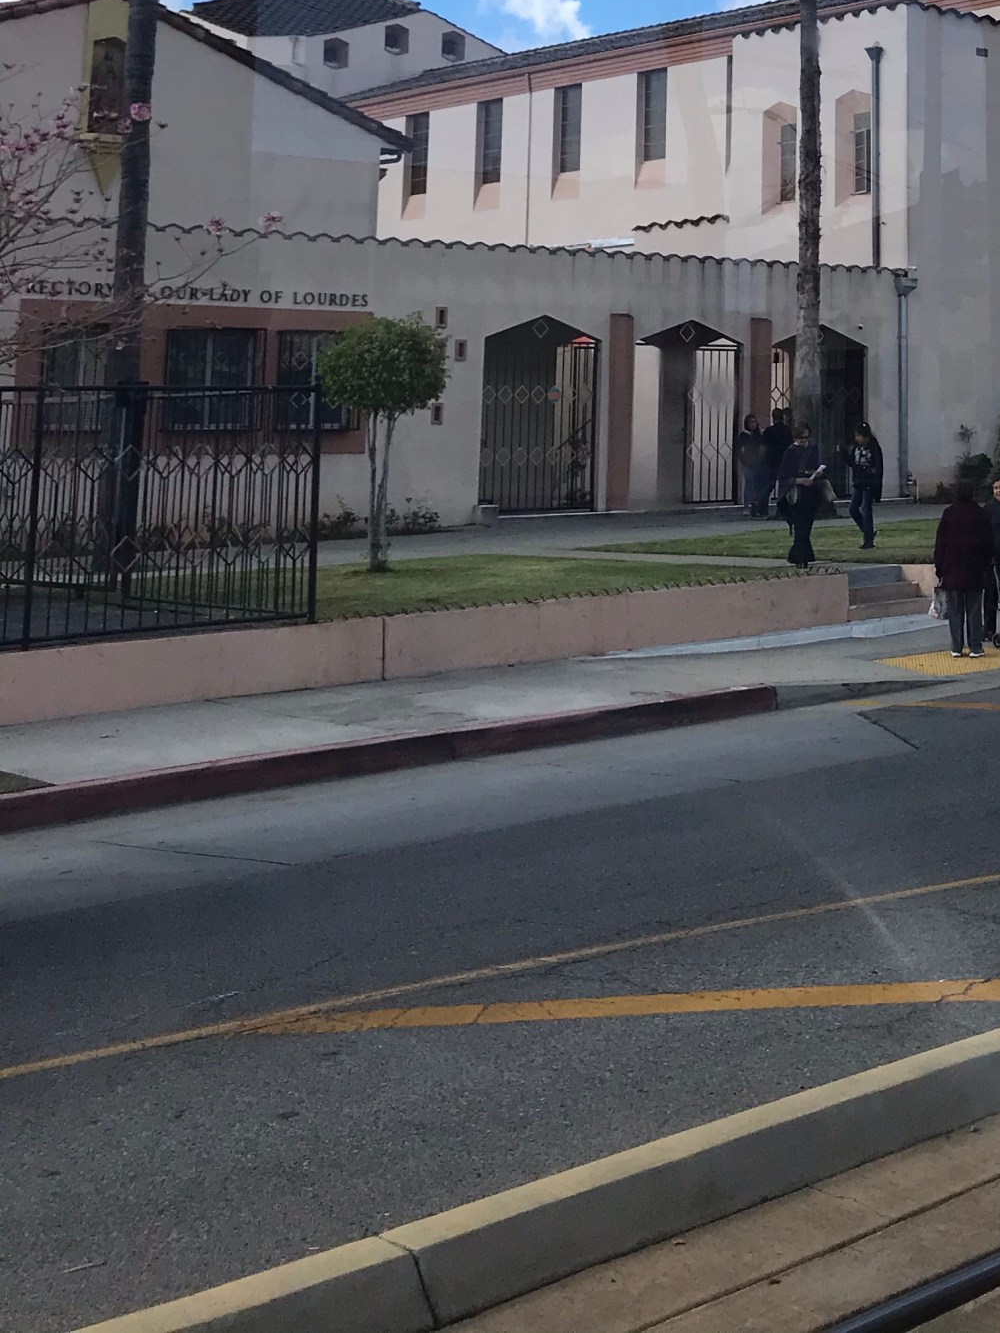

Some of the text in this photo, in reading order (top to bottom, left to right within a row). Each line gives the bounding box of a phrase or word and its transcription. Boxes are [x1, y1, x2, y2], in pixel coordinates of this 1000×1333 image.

[160, 285, 200, 301] OUR
[208, 287, 251, 303] LADY
[259, 290, 284, 304] OF
[293, 291, 369, 308] LOURDES
